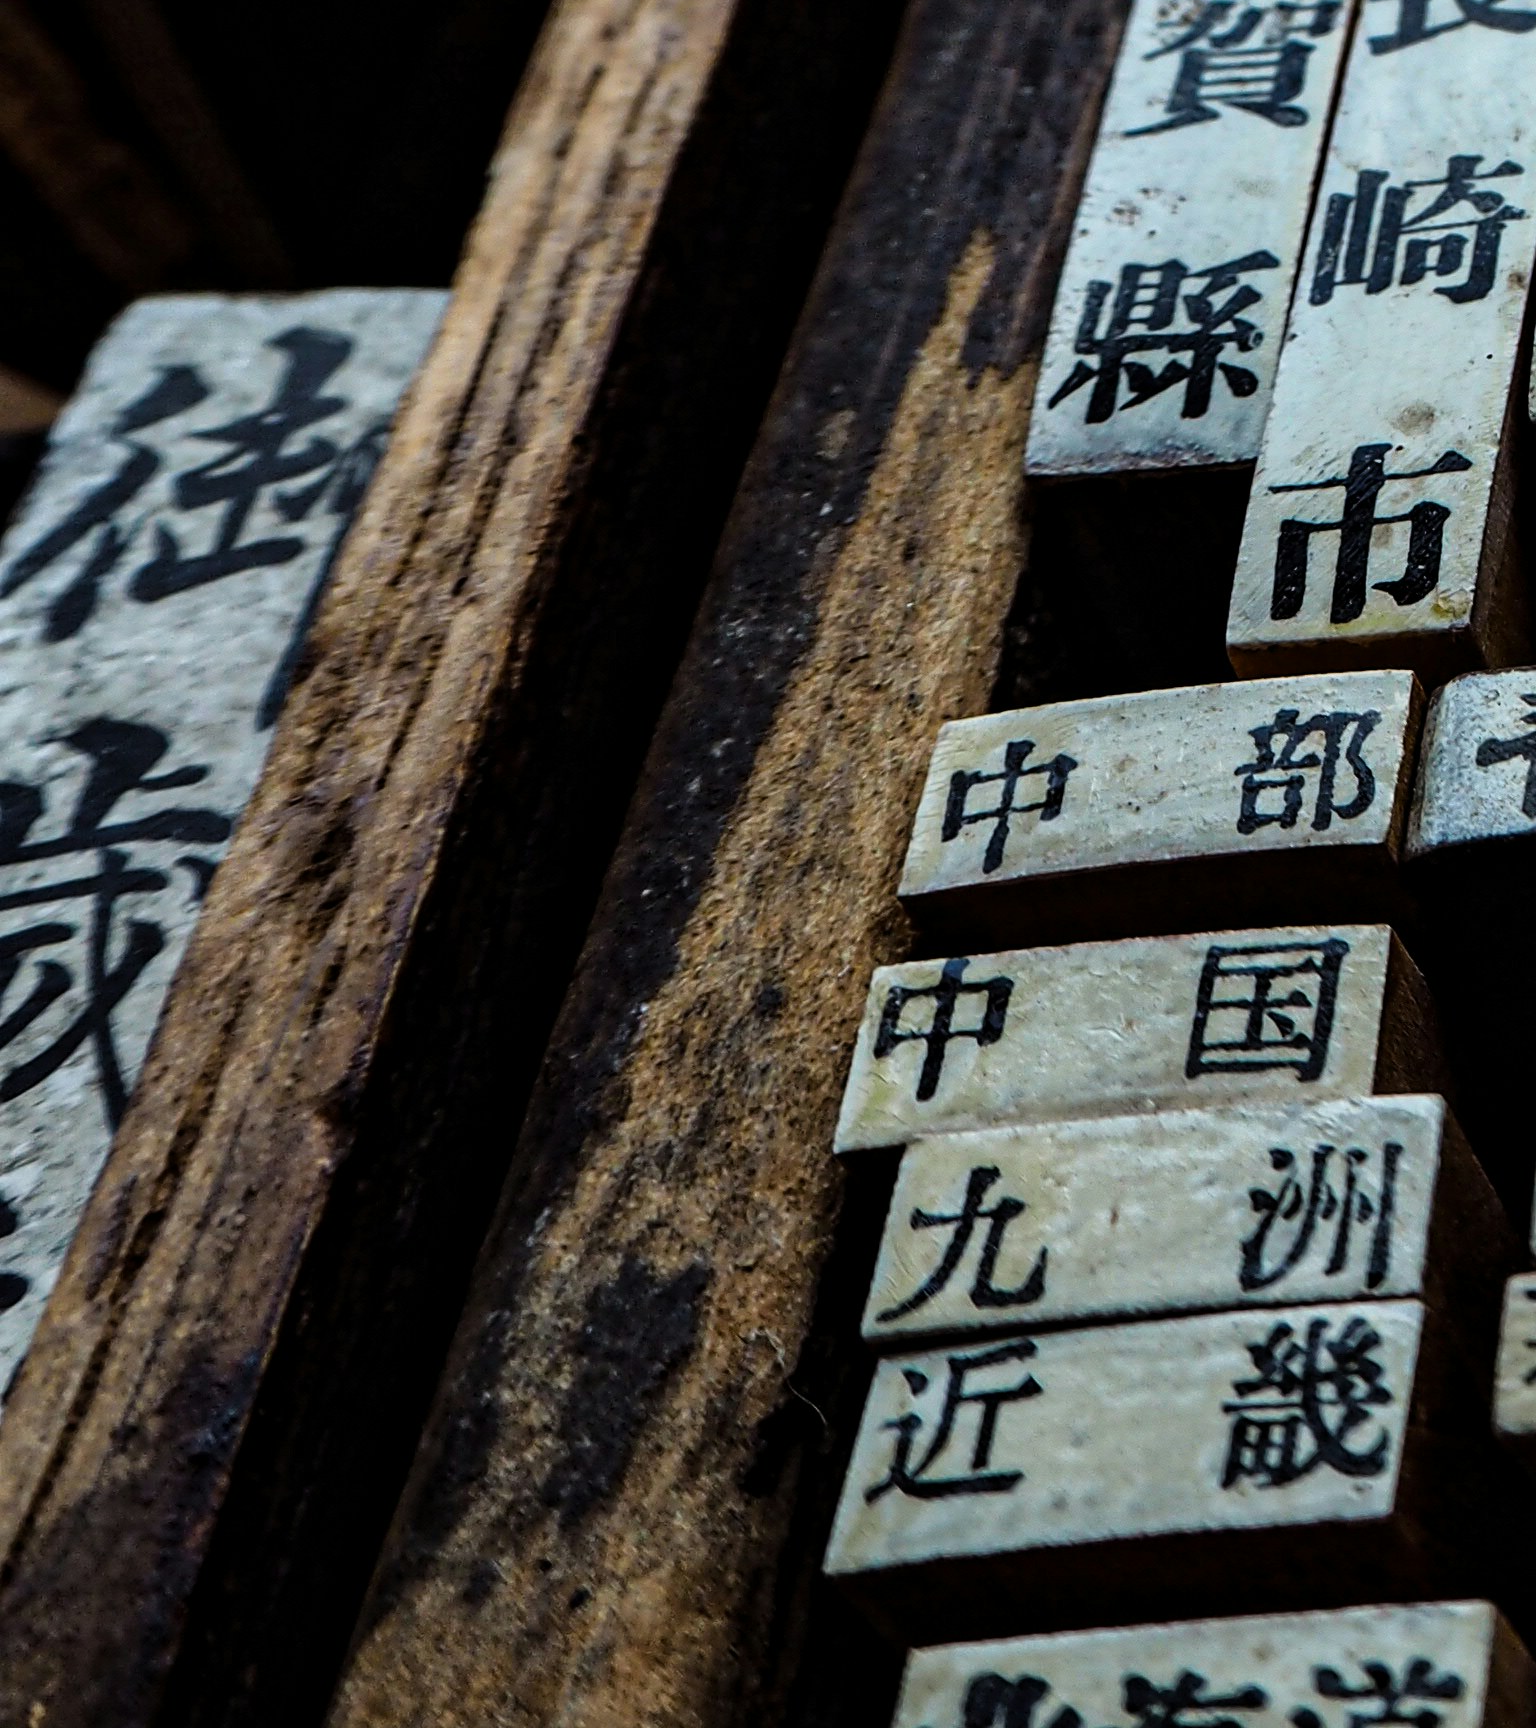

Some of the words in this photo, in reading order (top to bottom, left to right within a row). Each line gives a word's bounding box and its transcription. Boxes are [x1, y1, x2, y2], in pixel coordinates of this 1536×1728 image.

[940, 707, 1383, 874] 中部
[872, 937, 1352, 1103] 中国
[872, 1140, 1405, 1325] 九洲
[864, 1314, 1396, 1504] 近畿
